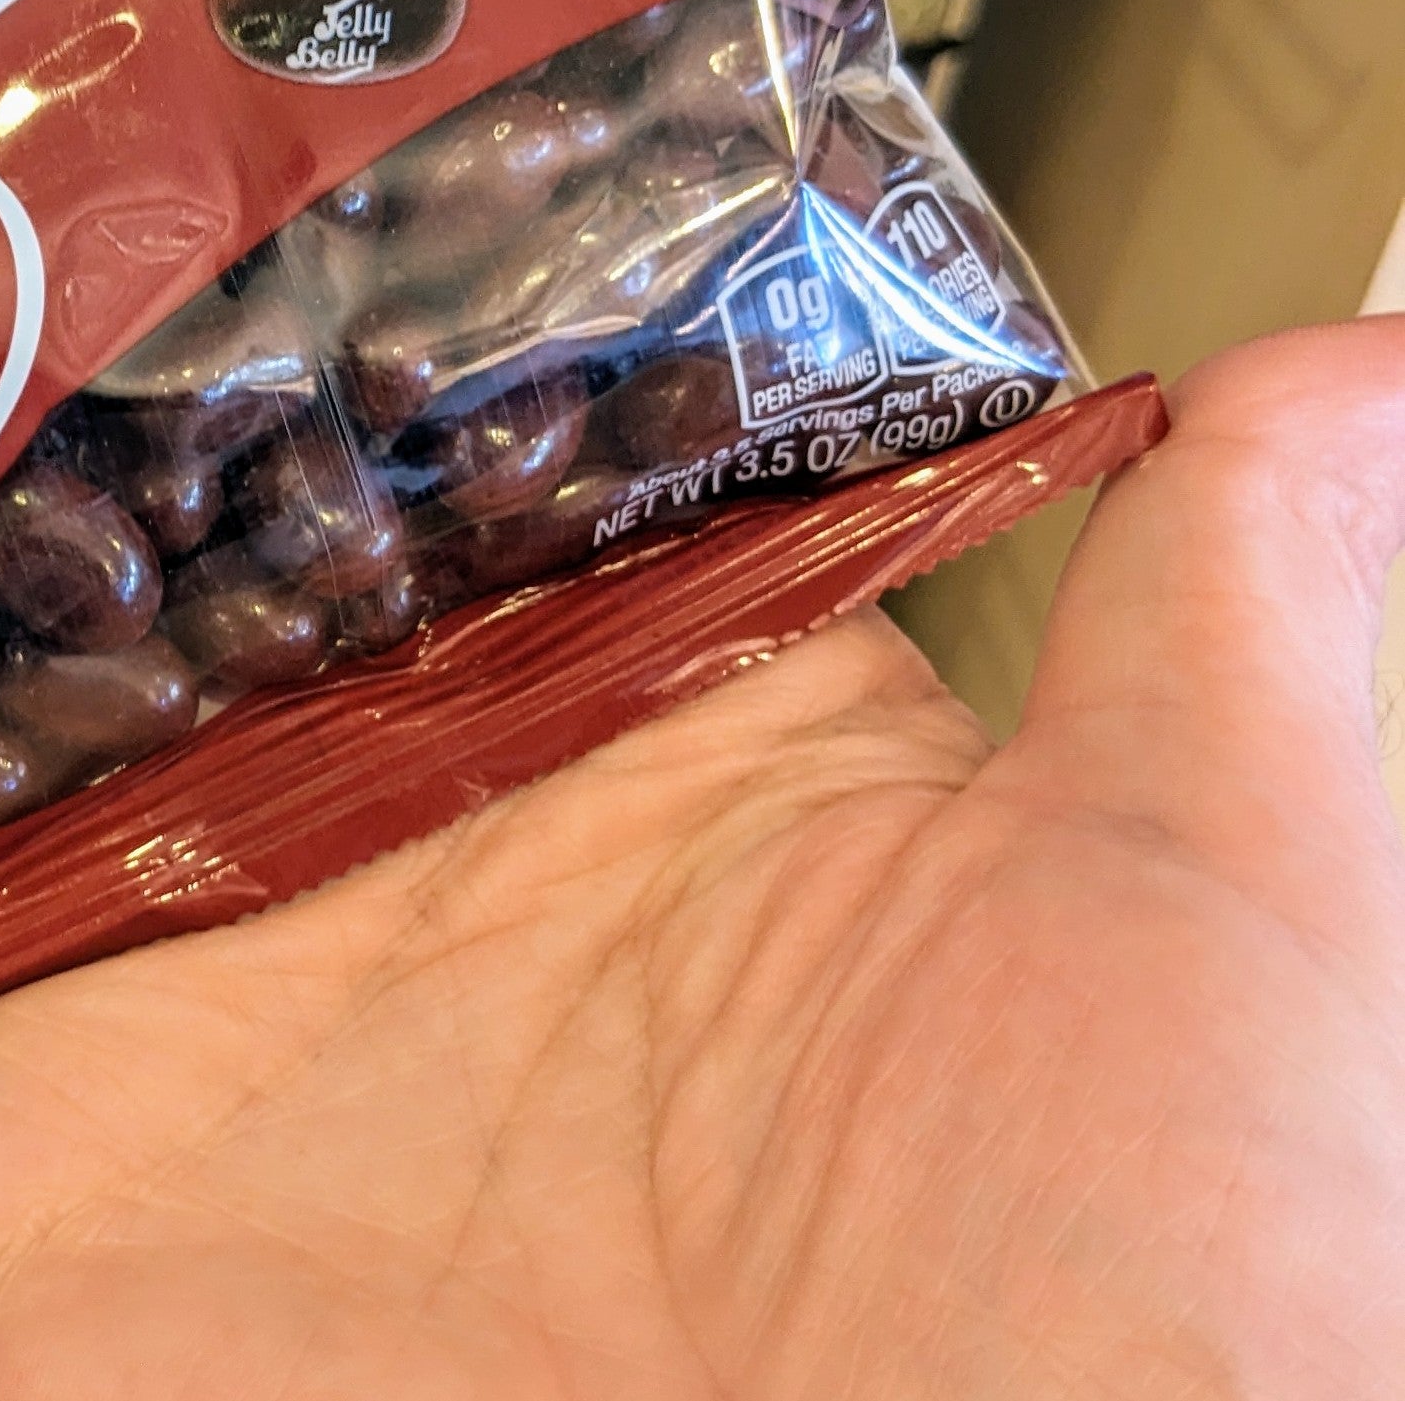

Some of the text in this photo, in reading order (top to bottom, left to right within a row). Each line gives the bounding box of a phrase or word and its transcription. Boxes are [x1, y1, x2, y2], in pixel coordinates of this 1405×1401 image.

[285, 36, 379, 85] Belly
[887, 199, 946, 271] 110
[764, 275, 830, 331] 0g
[753, 349, 877, 418] PER SERVING
[880, 385, 929, 419] Per
[593, 486, 665, 548] NET
[671, 458, 733, 507] WT
[734, 438, 796, 482] 3.5
[806, 430, 861, 474] OZ
[869, 398, 965, 458] (99g)
